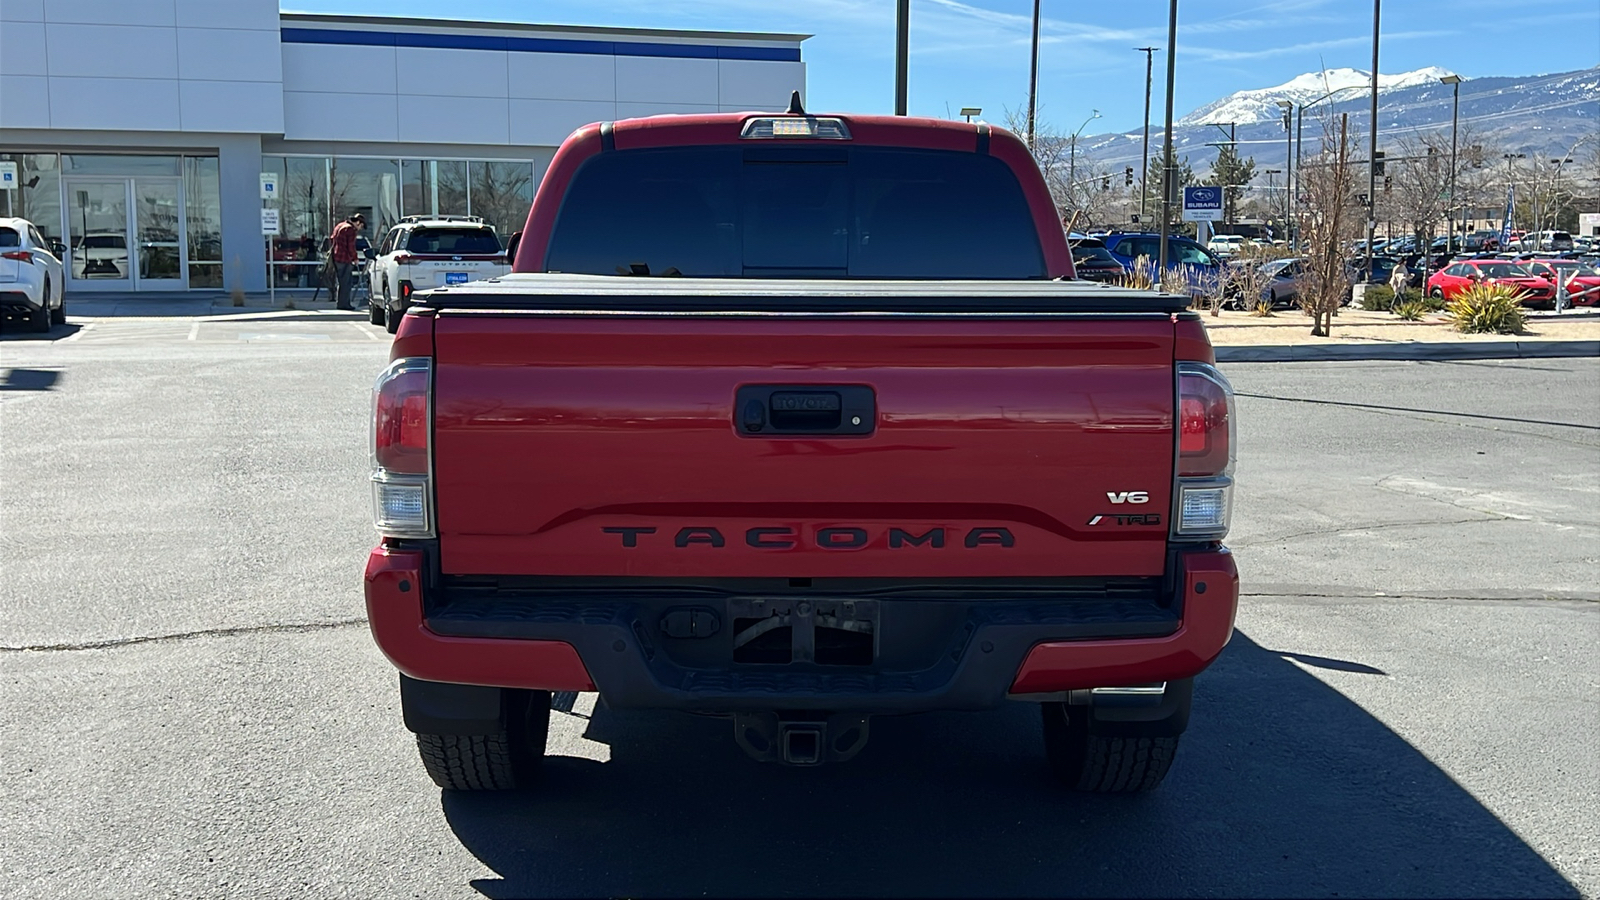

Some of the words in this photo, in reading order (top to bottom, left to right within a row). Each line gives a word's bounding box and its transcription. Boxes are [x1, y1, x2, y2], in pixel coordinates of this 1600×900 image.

[1106, 490, 1150, 504] V6
[1113, 514, 1161, 526] TRD
[599, 525, 1017, 549] TACOMA
